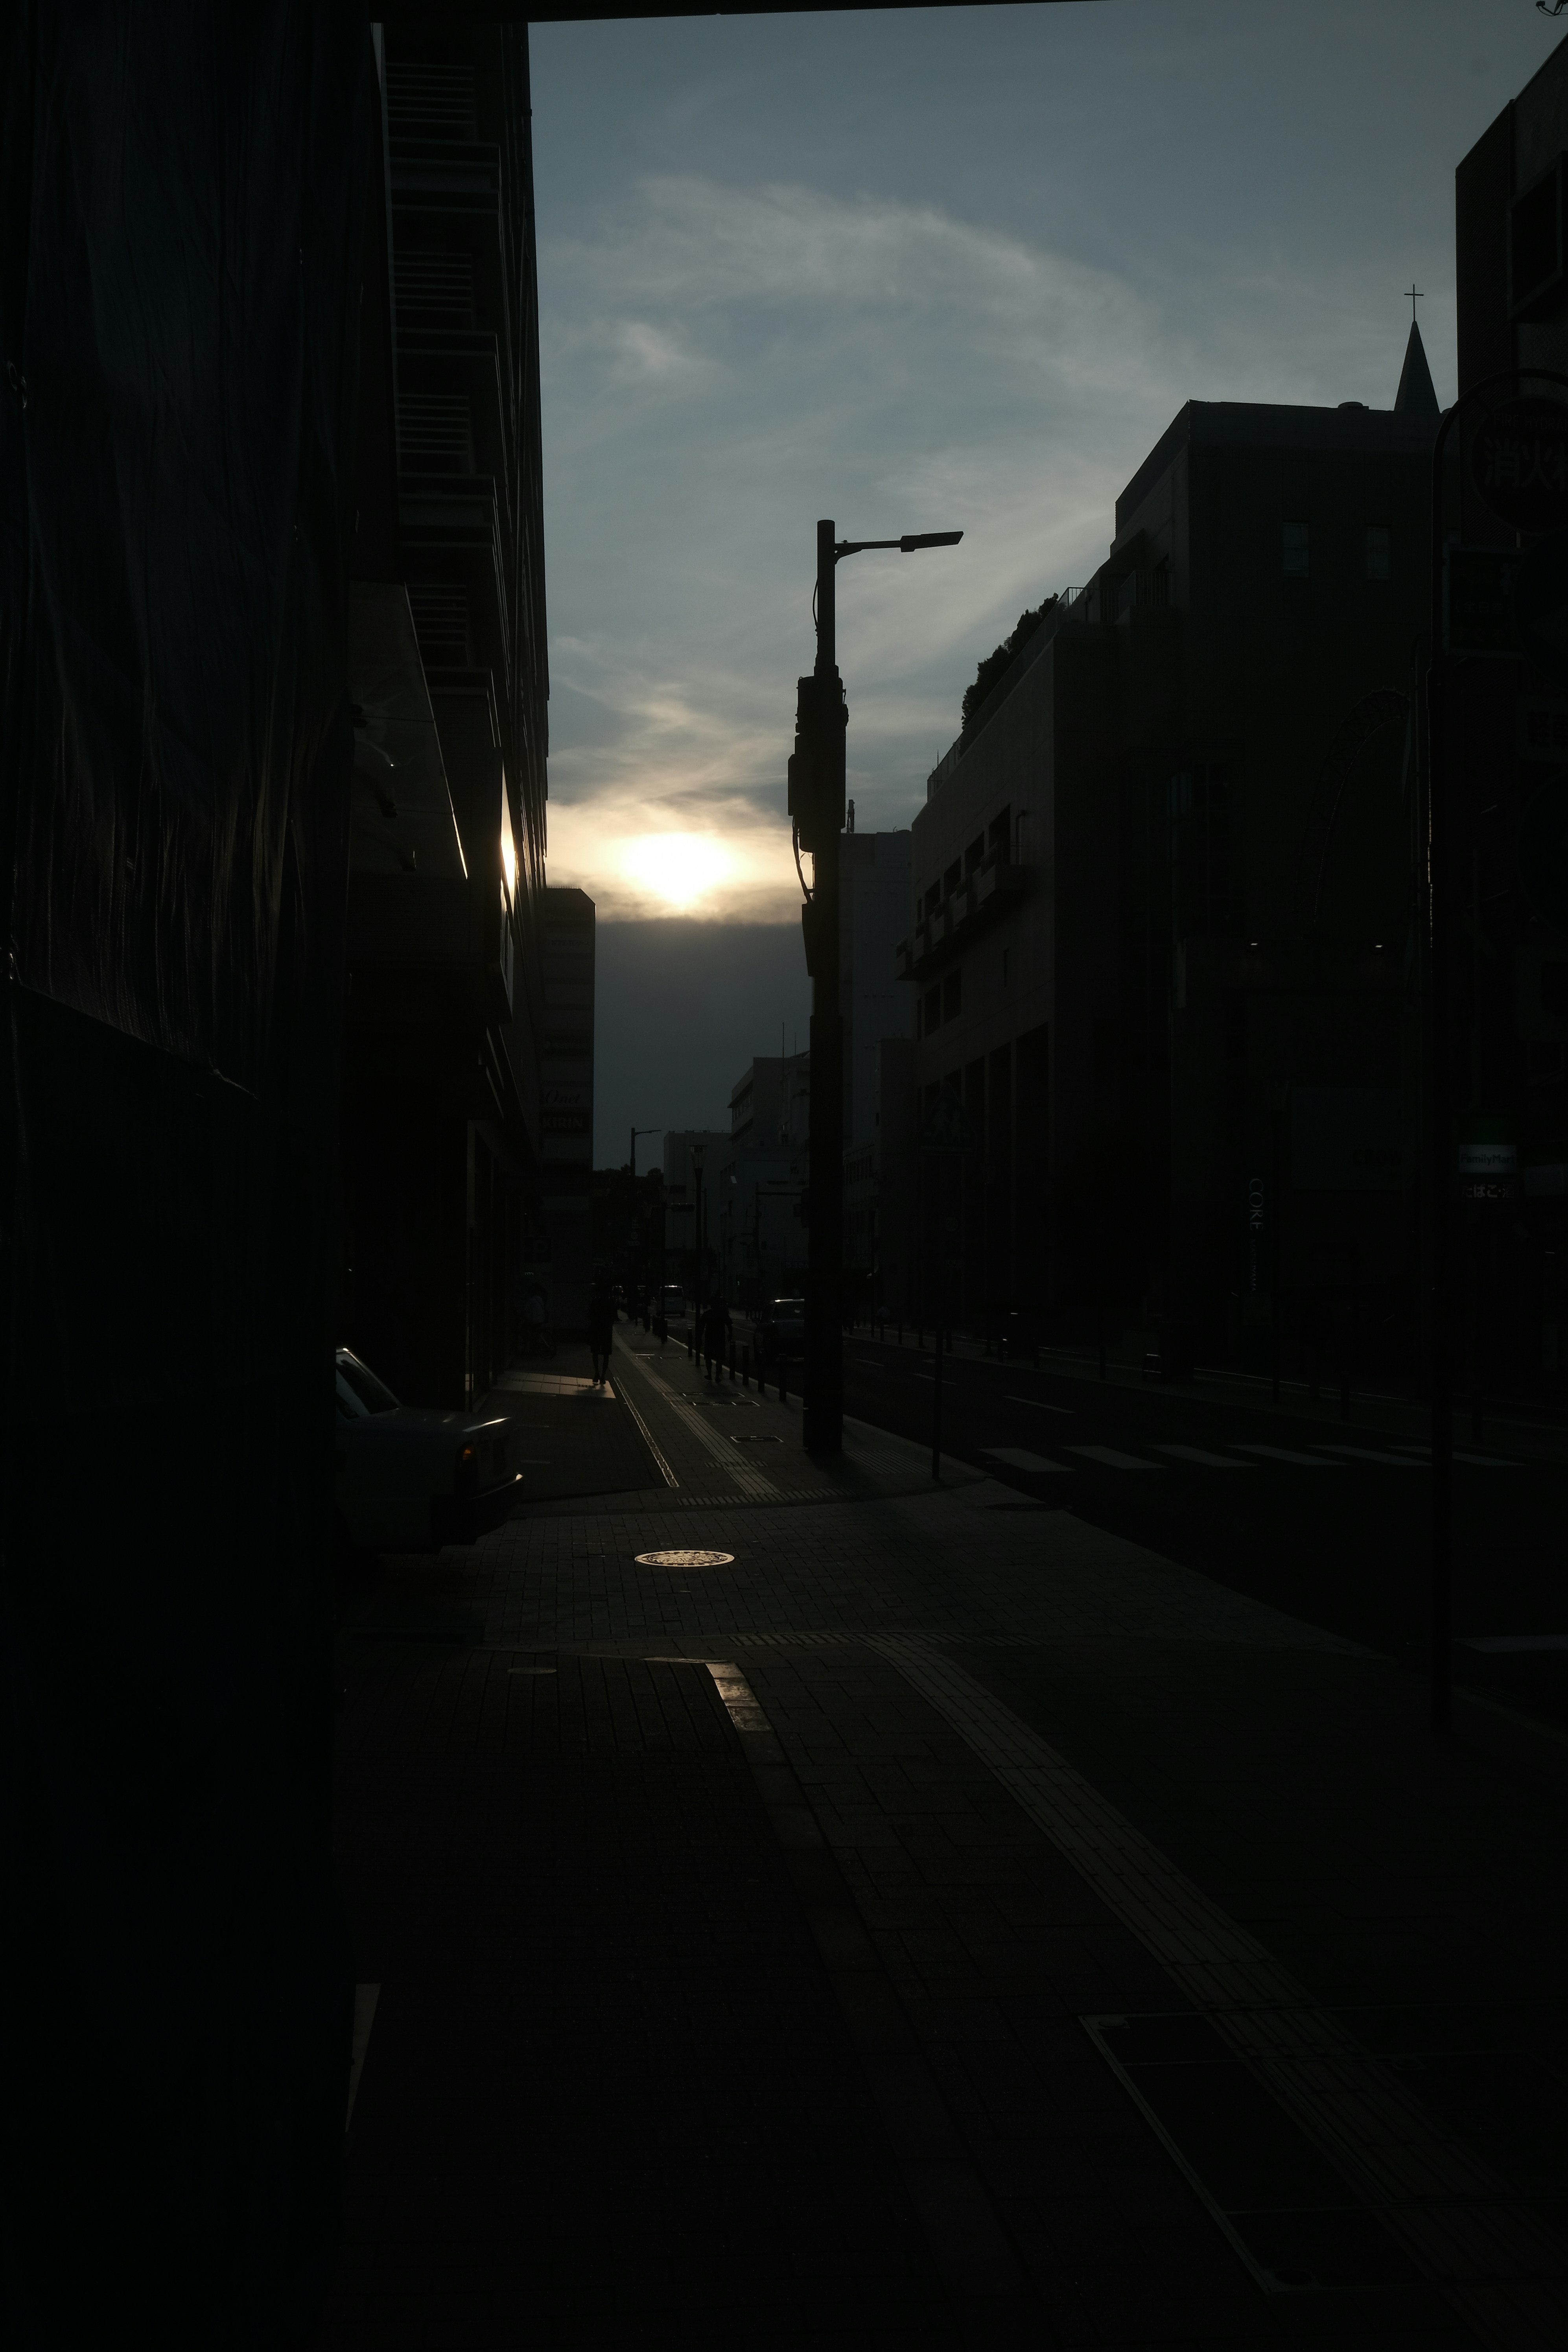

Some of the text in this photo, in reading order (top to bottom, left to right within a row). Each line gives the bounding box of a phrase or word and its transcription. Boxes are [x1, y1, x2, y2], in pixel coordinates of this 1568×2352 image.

[1494, 413, 1519, 428] FIRE
[542, 1117, 583, 1128] KIRIN
[1461, 1154, 1515, 1165] FamilyMart
[1249, 1178, 1264, 1230] CORE
